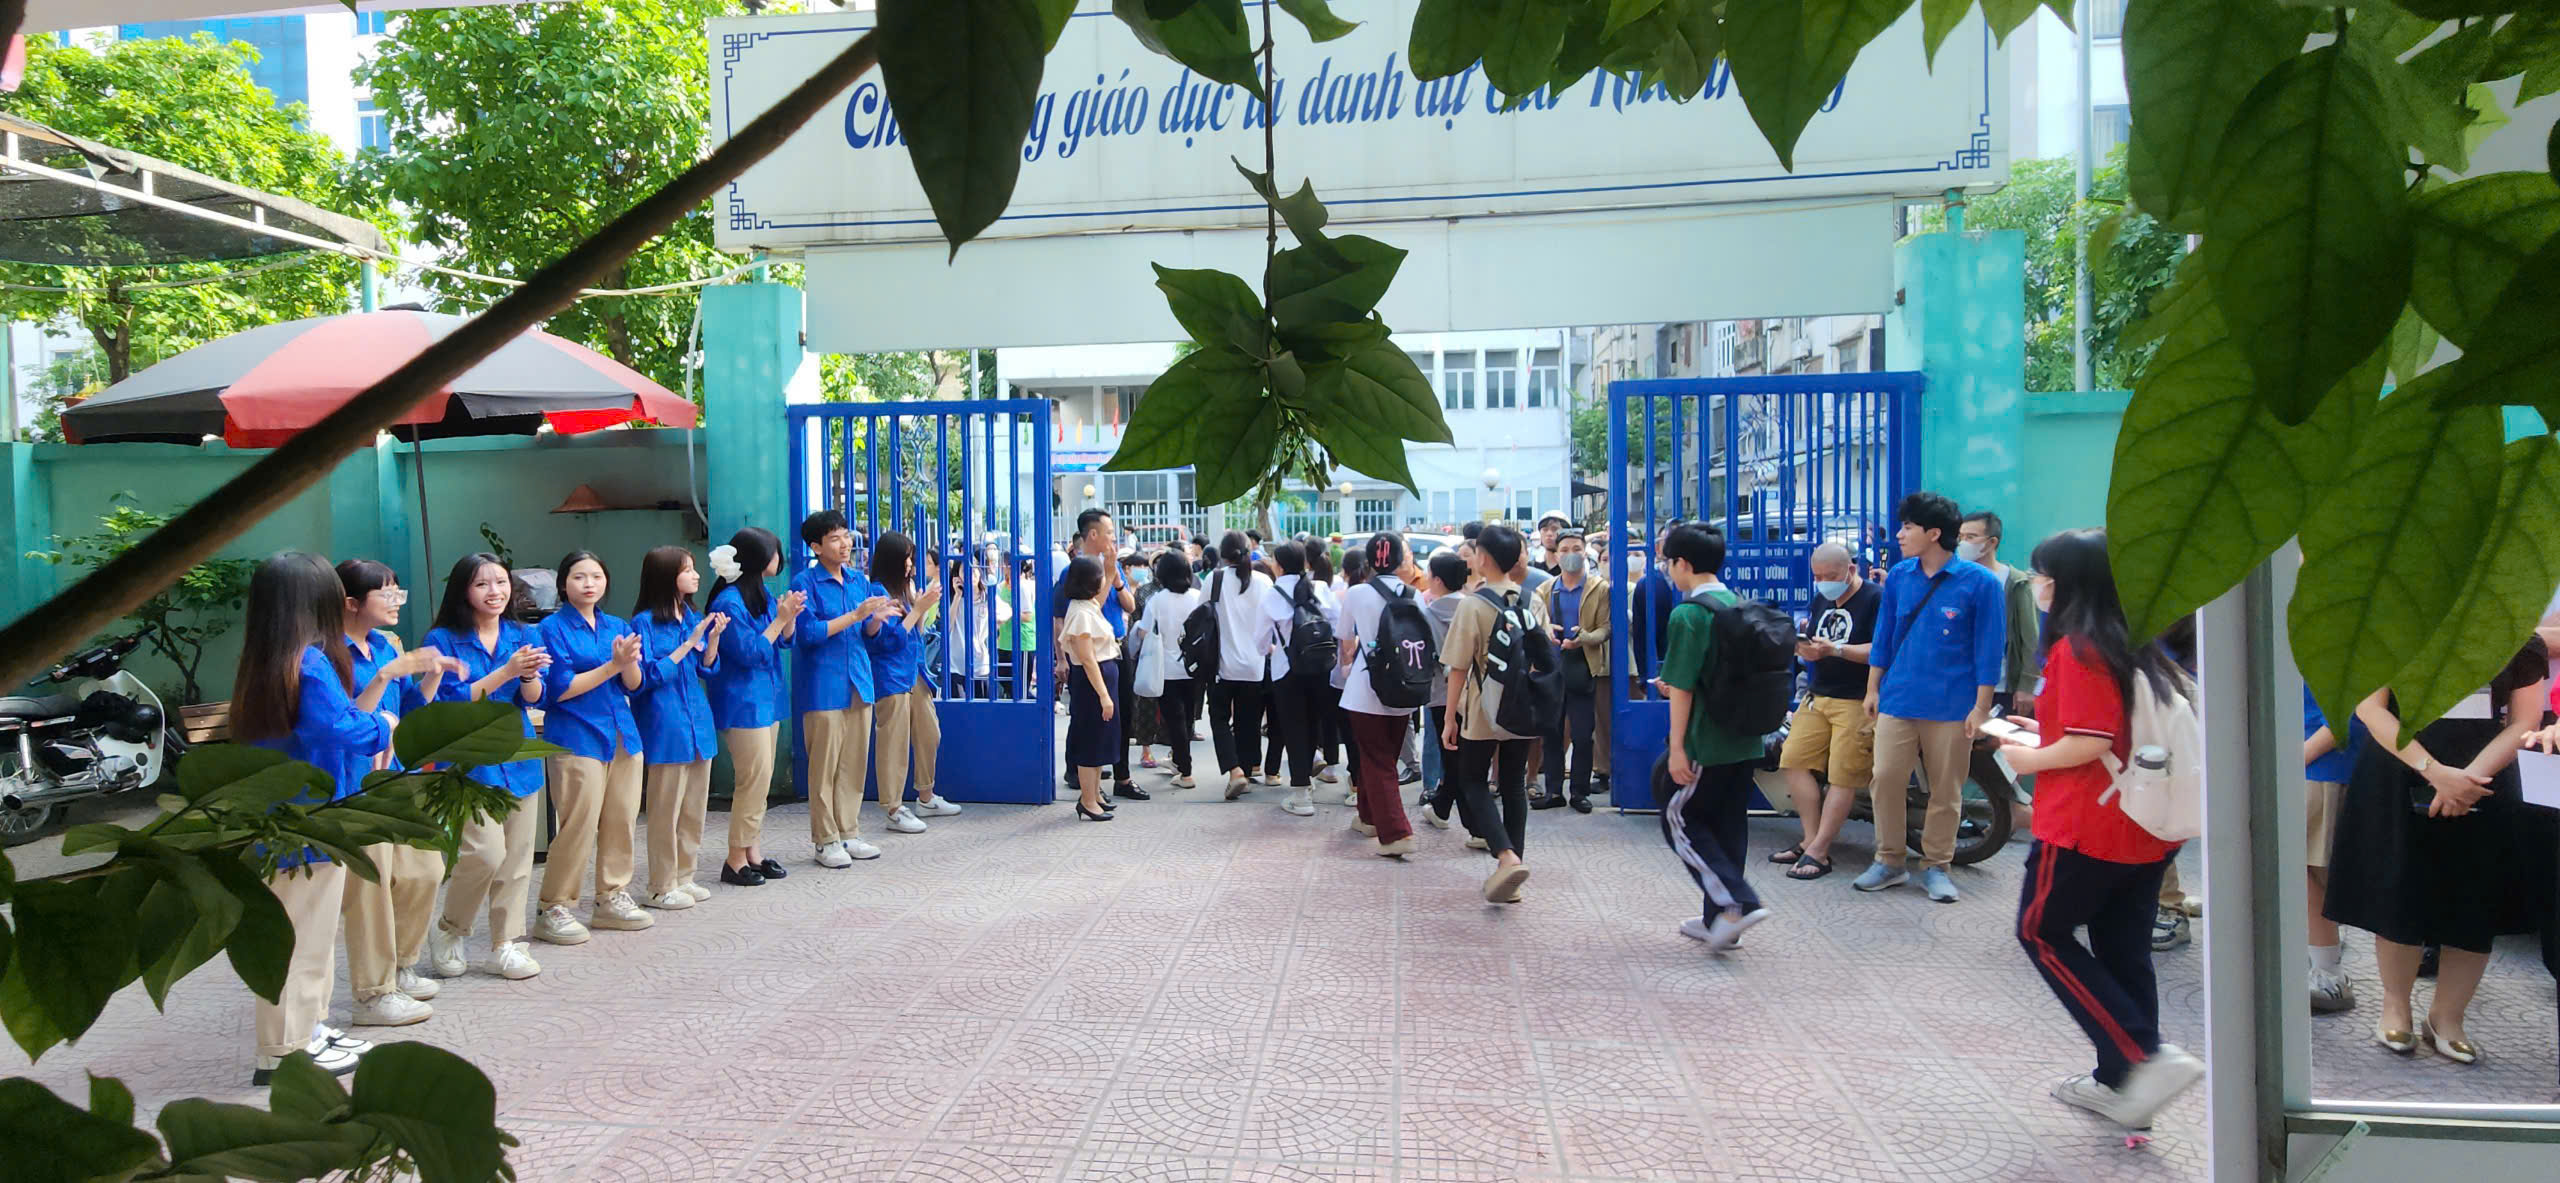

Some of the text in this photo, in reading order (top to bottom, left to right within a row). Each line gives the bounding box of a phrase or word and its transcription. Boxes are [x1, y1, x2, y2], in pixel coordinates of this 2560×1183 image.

[1059, 68, 1149, 158] giáo
[1159, 67, 1235, 148] dục
[1298, 51, 1406, 126] danh
[1724, 566, 1751, 580] CNG
[1776, 588, 1808, 601] THNG
